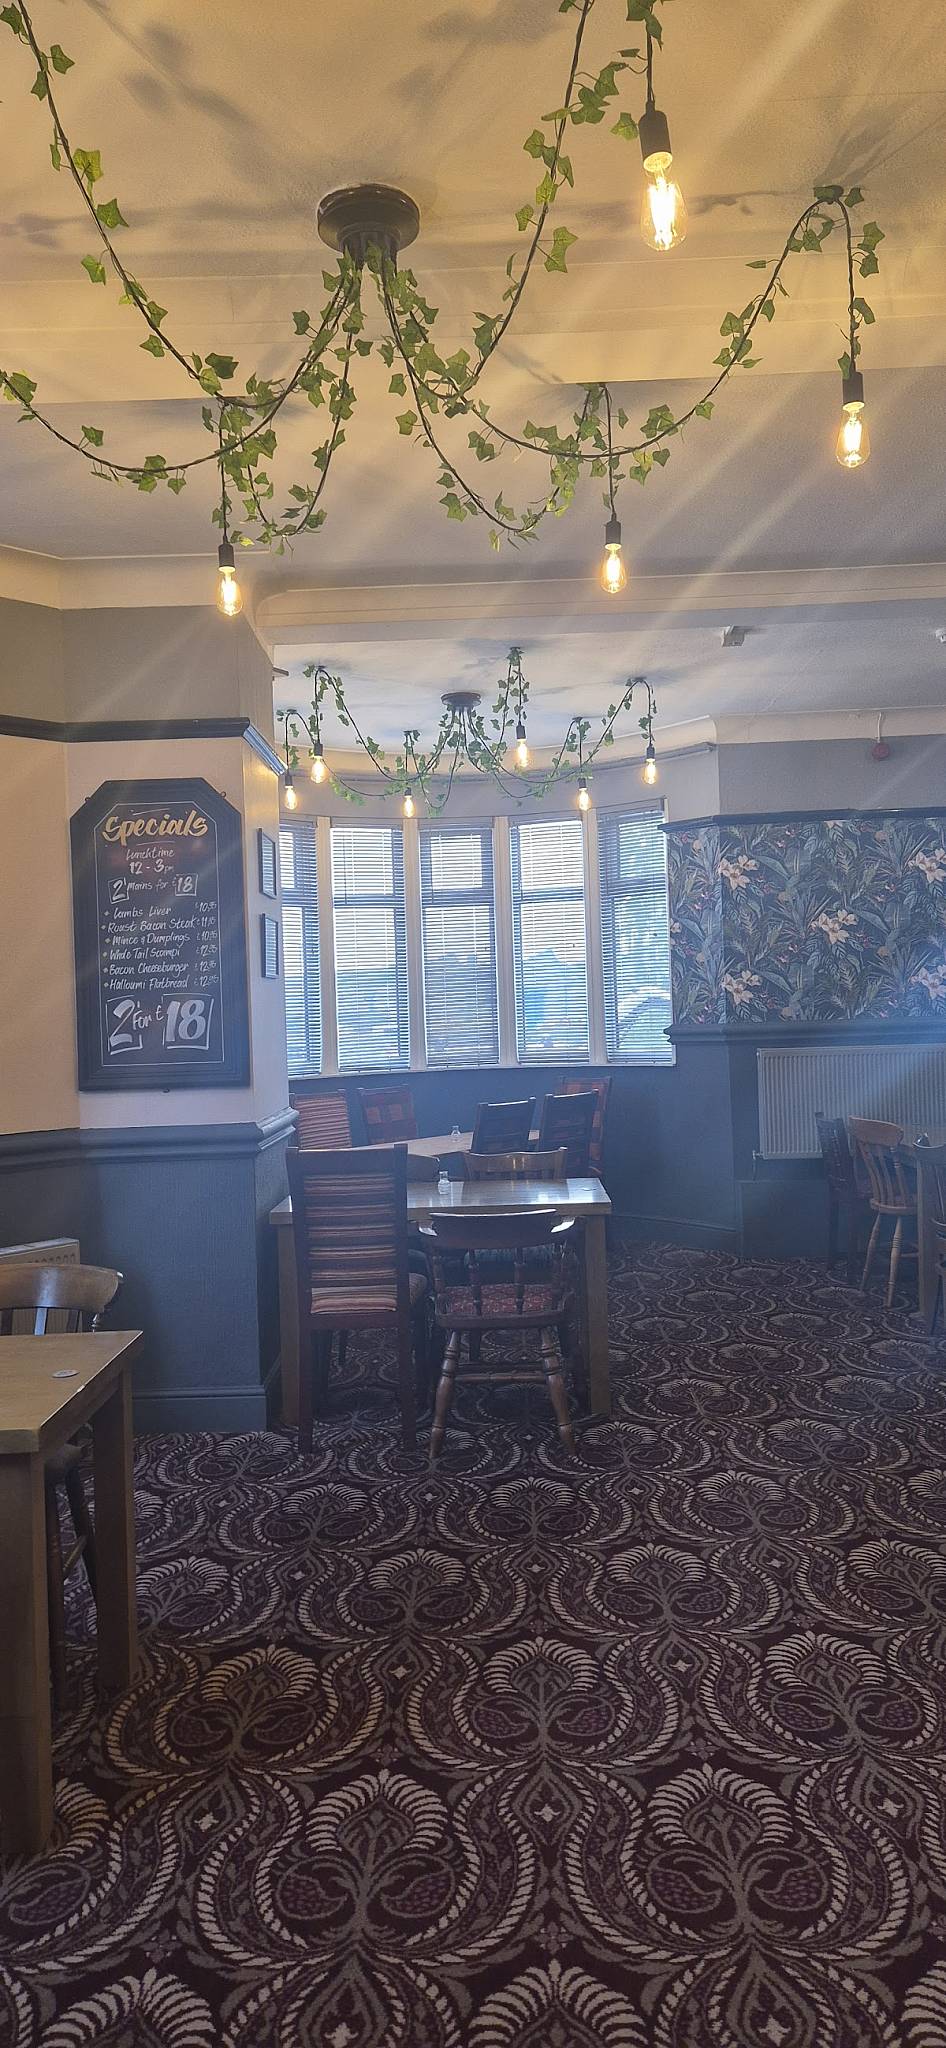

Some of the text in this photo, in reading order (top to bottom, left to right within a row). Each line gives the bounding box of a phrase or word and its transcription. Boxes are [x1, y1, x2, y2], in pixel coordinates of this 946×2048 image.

[102, 810, 208, 846] Specials
[129, 861, 143, 875] 12
[140, 920, 167, 931] Bacon
[146, 931, 190, 948] Dumplings
[109, 963, 135, 975] Bacon
